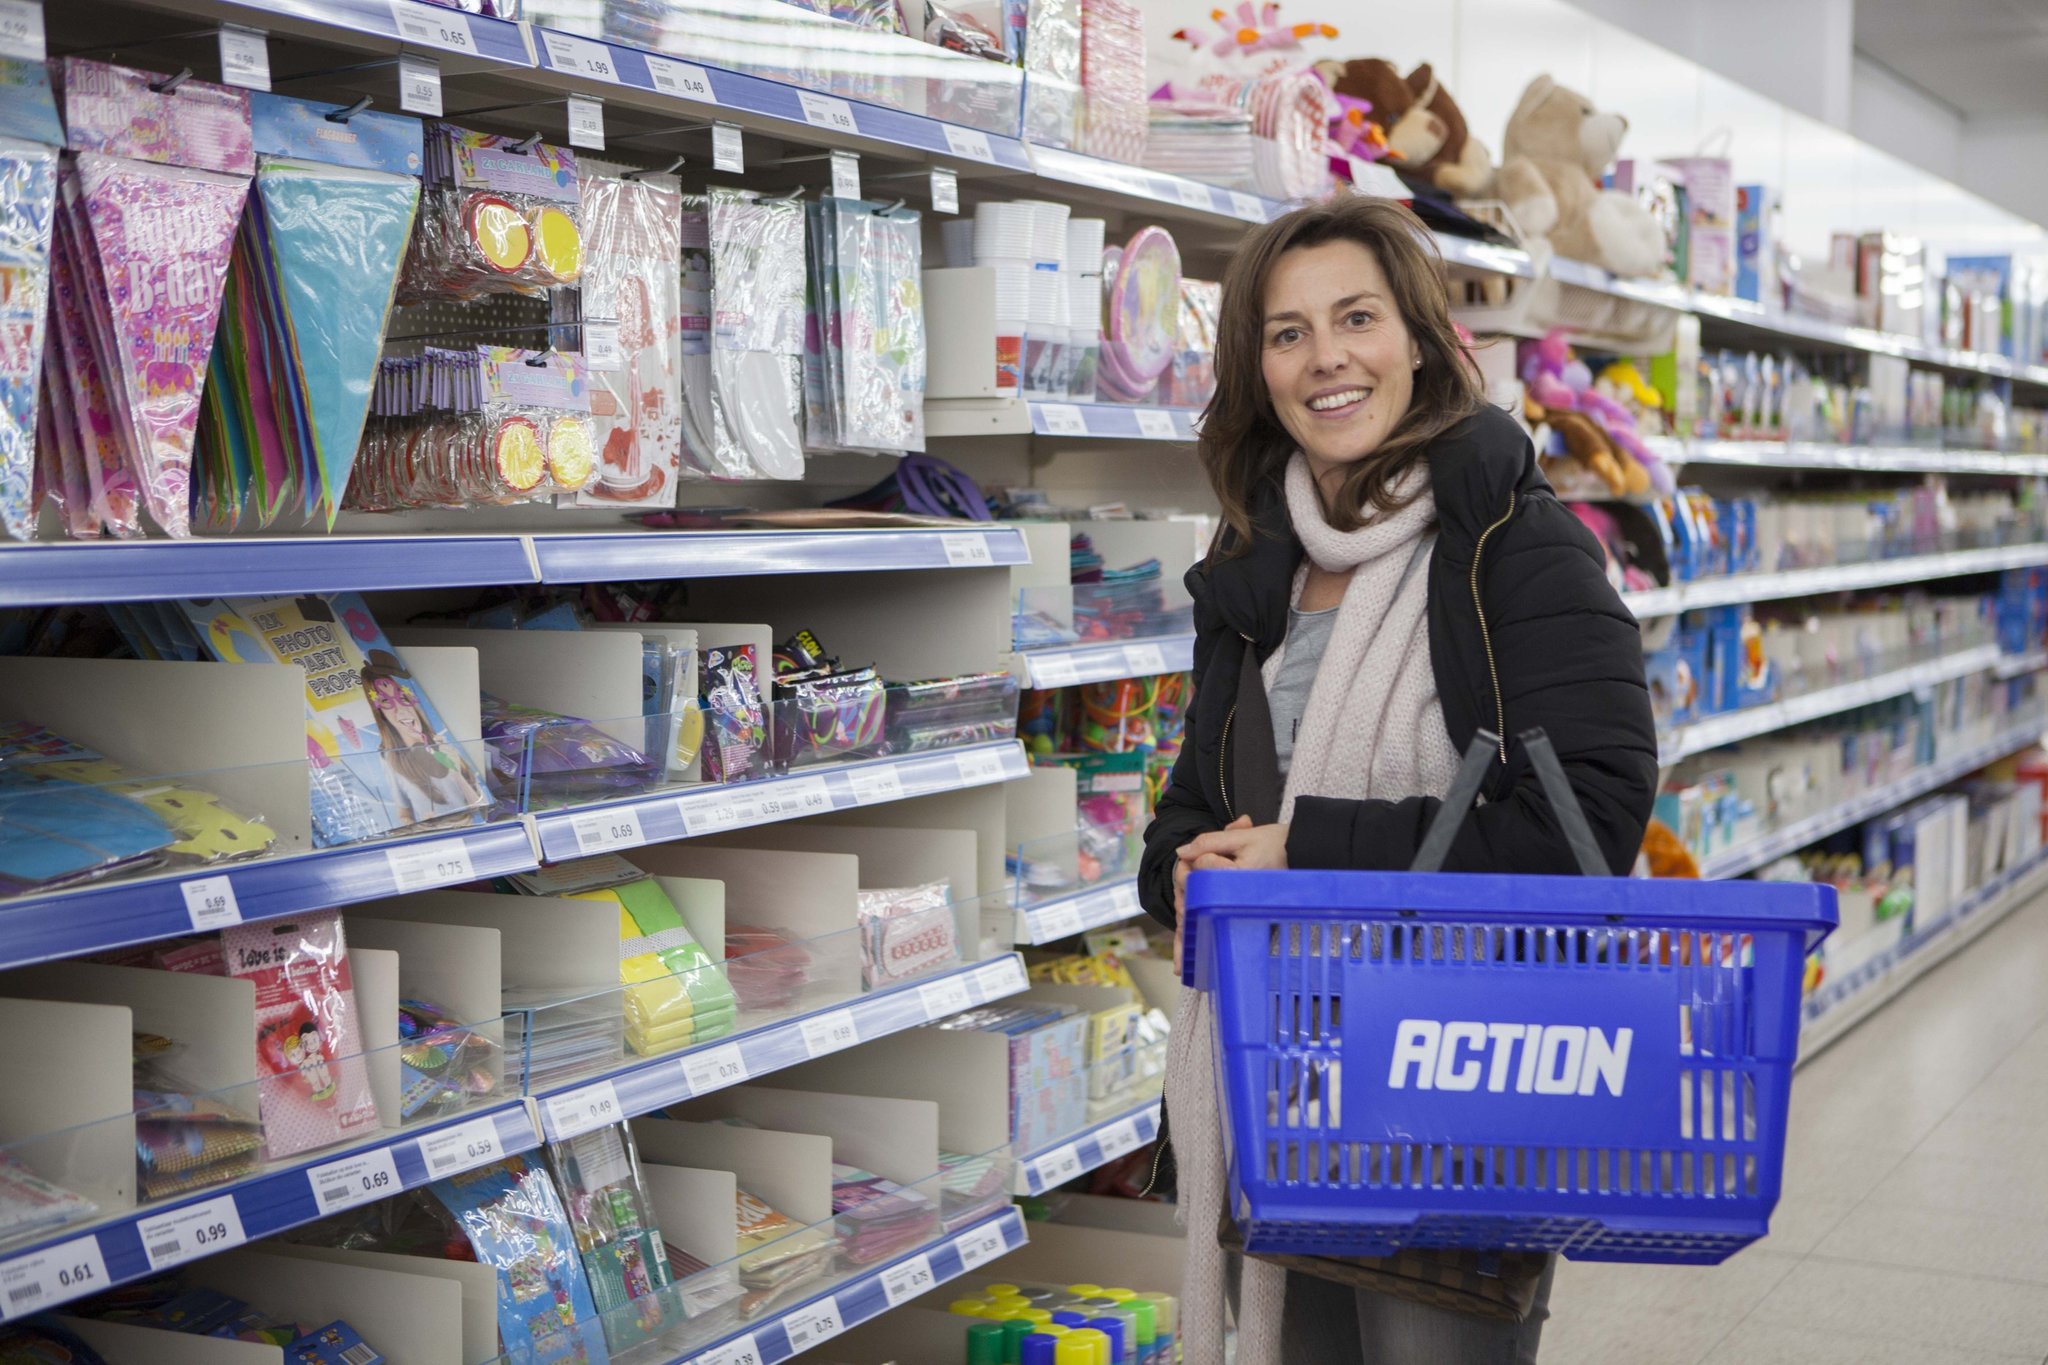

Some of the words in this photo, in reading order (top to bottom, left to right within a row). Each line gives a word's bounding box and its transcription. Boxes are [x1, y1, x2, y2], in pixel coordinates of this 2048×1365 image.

[440, 28, 467, 46] 0.65
[587, 59, 609, 75] 1.99
[684, 79, 705, 93] 0.49
[127, 256, 217, 314] B-day
[271, 625, 333, 655] PHOTO
[797, 630, 822, 659] GLOW
[292, 647, 347, 673] PARTY
[308, 669, 363, 697] PROPS
[762, 801, 781, 815] 0.59
[611, 824, 633, 839] 0.69
[437, 861, 464, 878] 0.75
[1388, 1019, 1634, 1097] ACTION
[590, 1100, 612, 1117] 0.49
[467, 1139, 492, 1157] 0.59
[362, 1171, 389, 1190] 0.69
[196, 1222, 227, 1244] 0.99
[59, 1262, 94, 1287] 0.61
[815, 1316, 834, 1334] 0.75
[735, 1353, 753, 1365] 039
